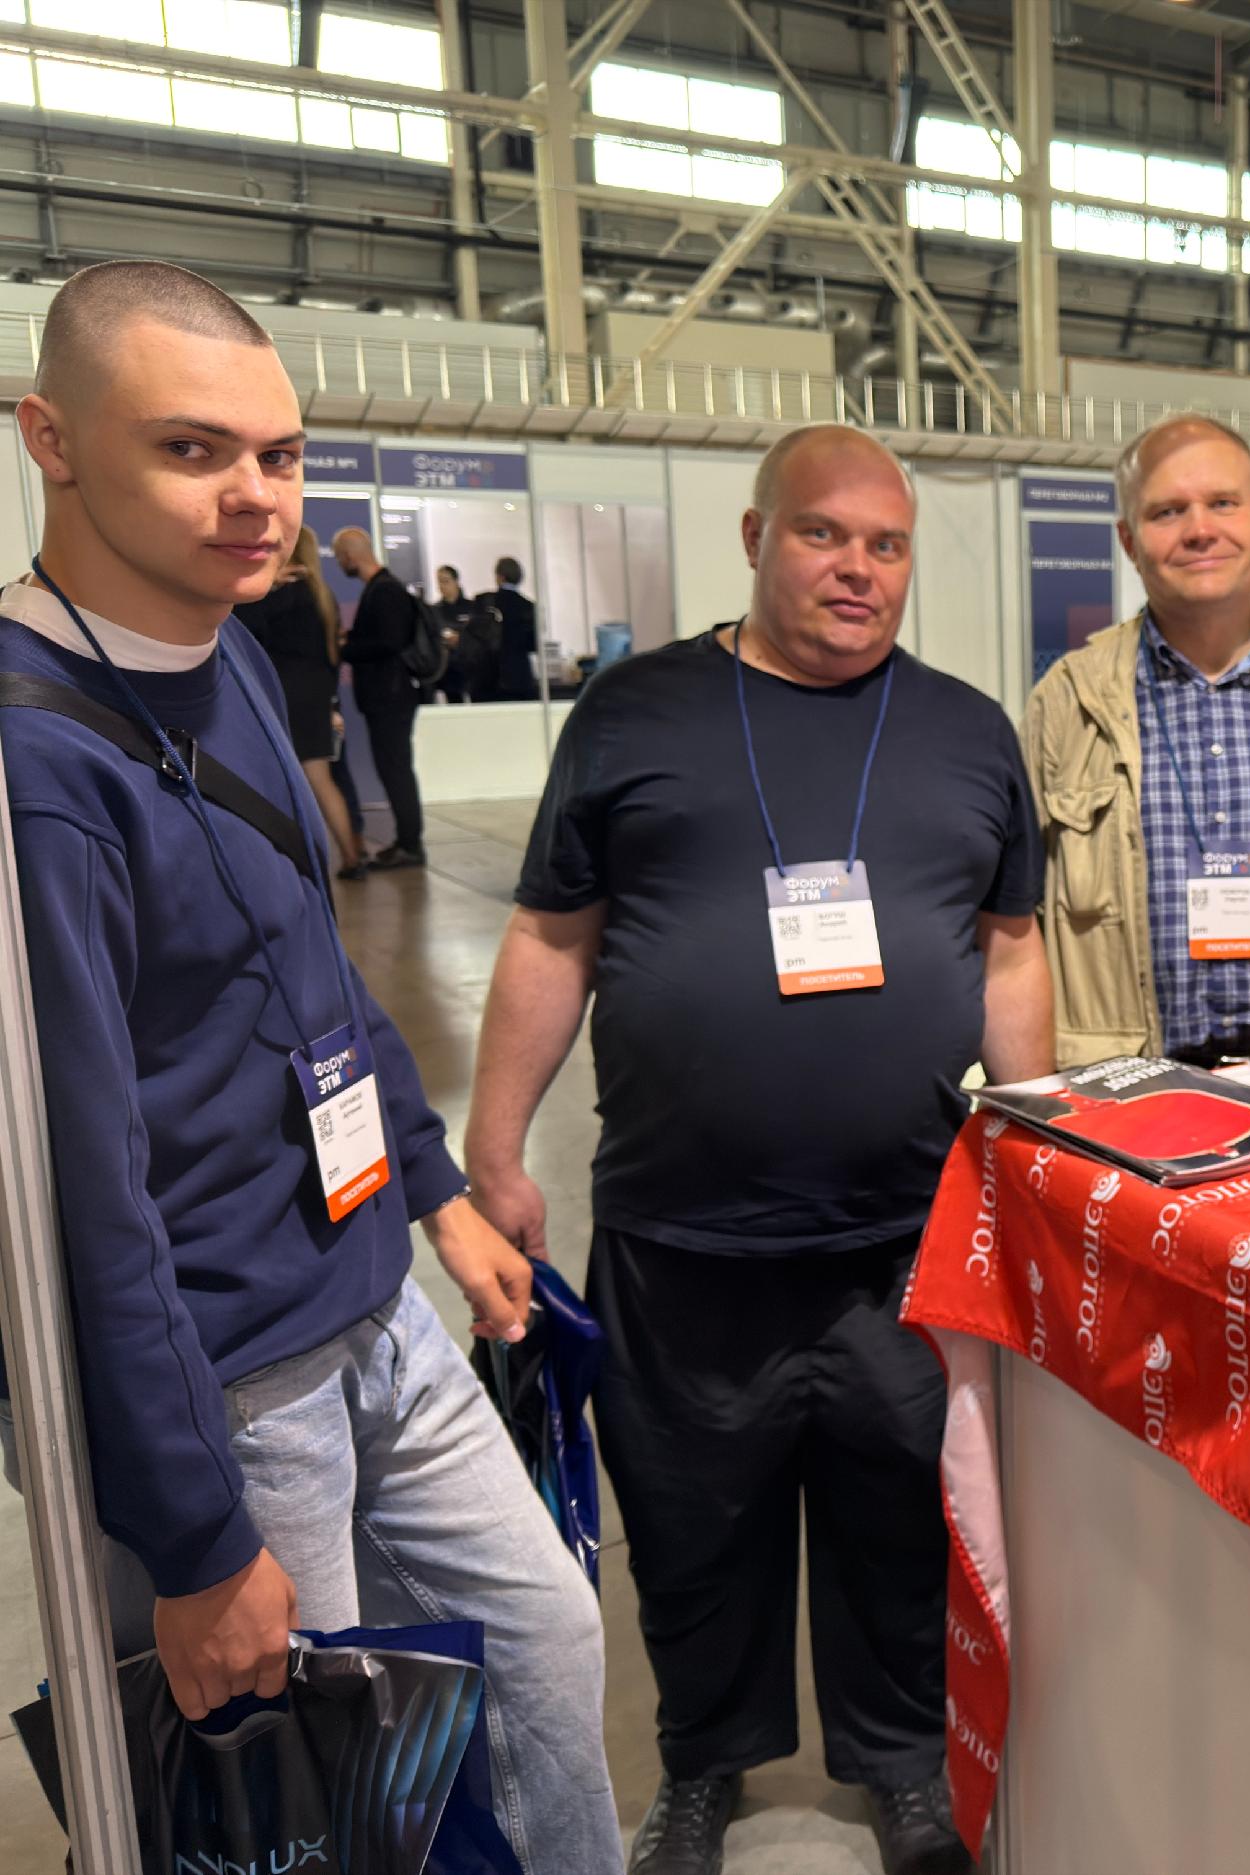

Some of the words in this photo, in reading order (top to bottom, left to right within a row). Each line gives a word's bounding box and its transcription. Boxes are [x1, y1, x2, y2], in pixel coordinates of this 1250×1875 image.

[412, 453, 482, 474] Форум
[413, 471, 457, 489] ЭТМ
[1203, 852, 1249, 865] Форум
[1204, 864, 1232, 875] ЭТМ
[784, 875, 840, 890] Форум
[785, 889, 822, 903] ЭТМ
[800, 971, 865, 986] ПОСЕТИТЕЛЬ
[313, 1049, 351, 1077] Форум
[317, 1071, 342, 1095] ЭТМ
[965, 1140, 999, 1277] ЭПОТОС
[1077, 1202, 1104, 1352] ЭПОТОС
[1224, 1269, 1249, 1432] ЭПОТОС
